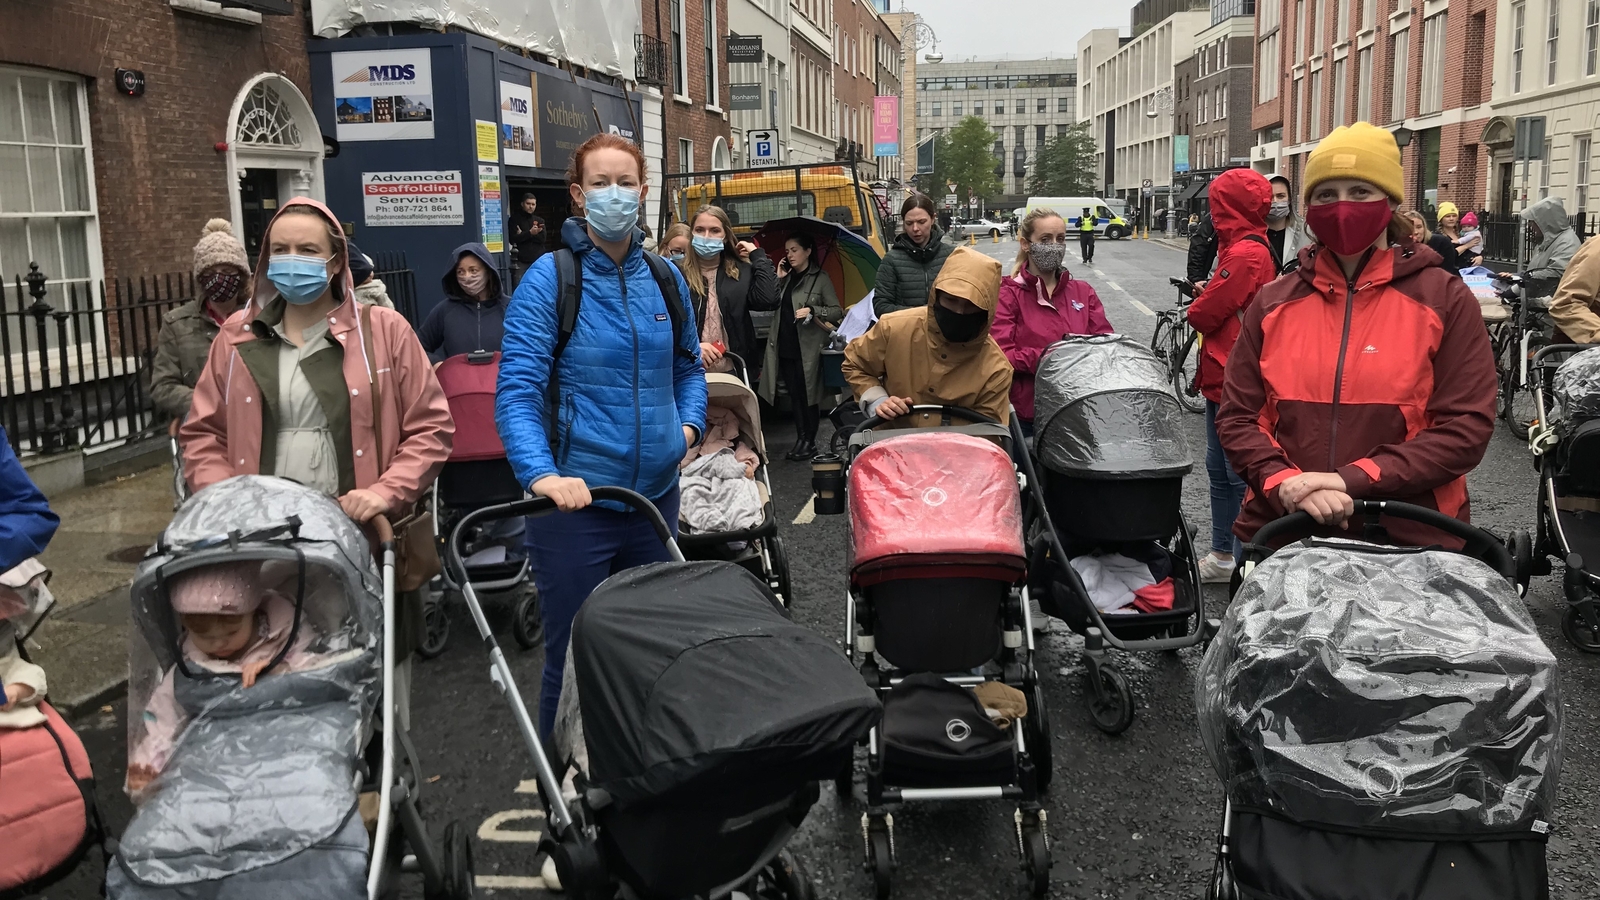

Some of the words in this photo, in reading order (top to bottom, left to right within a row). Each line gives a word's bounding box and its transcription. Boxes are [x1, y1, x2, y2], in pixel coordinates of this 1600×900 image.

[368, 64, 415, 81] MDS
[509, 97, 527, 115] MDS
[546, 100, 588, 131] Sotheby's
[760, 143, 769, 155] P
[751, 158, 777, 166] SETANTA
[371, 173, 454, 182] Advanced
[368, 184, 458, 193] Scaffolding
[379, 196, 447, 204] Services
